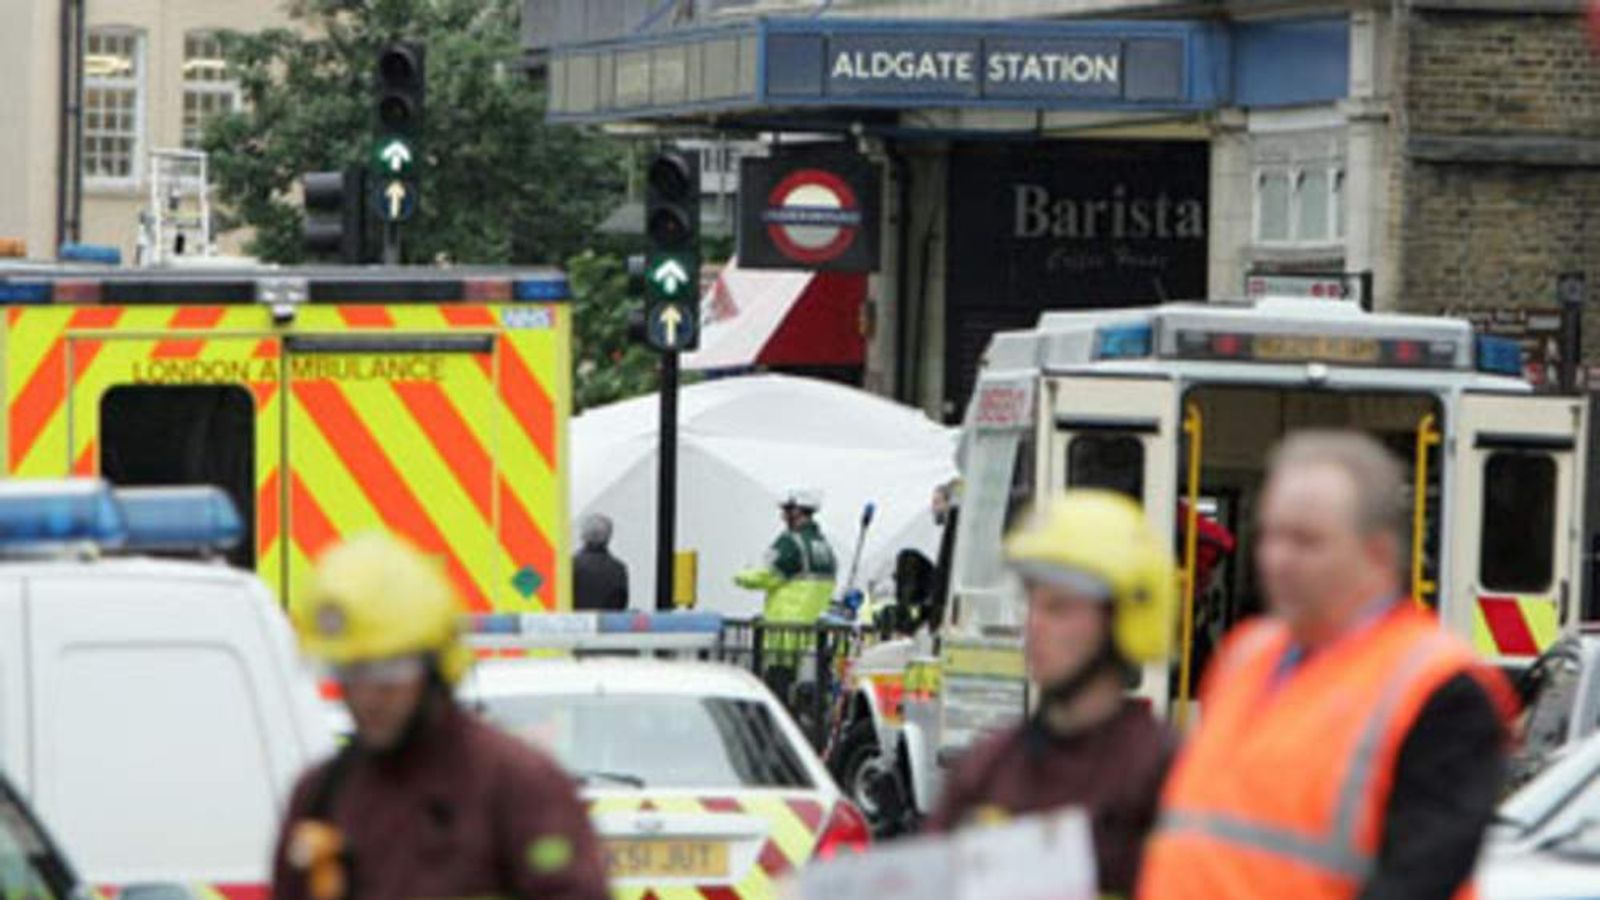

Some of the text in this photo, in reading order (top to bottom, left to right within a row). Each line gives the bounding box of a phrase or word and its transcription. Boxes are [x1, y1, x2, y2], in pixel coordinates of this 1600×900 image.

[831, 51, 1119, 84] ALDGATE STATION
[1013, 183, 1205, 239] Barista
[131, 360, 250, 384] LONDON
